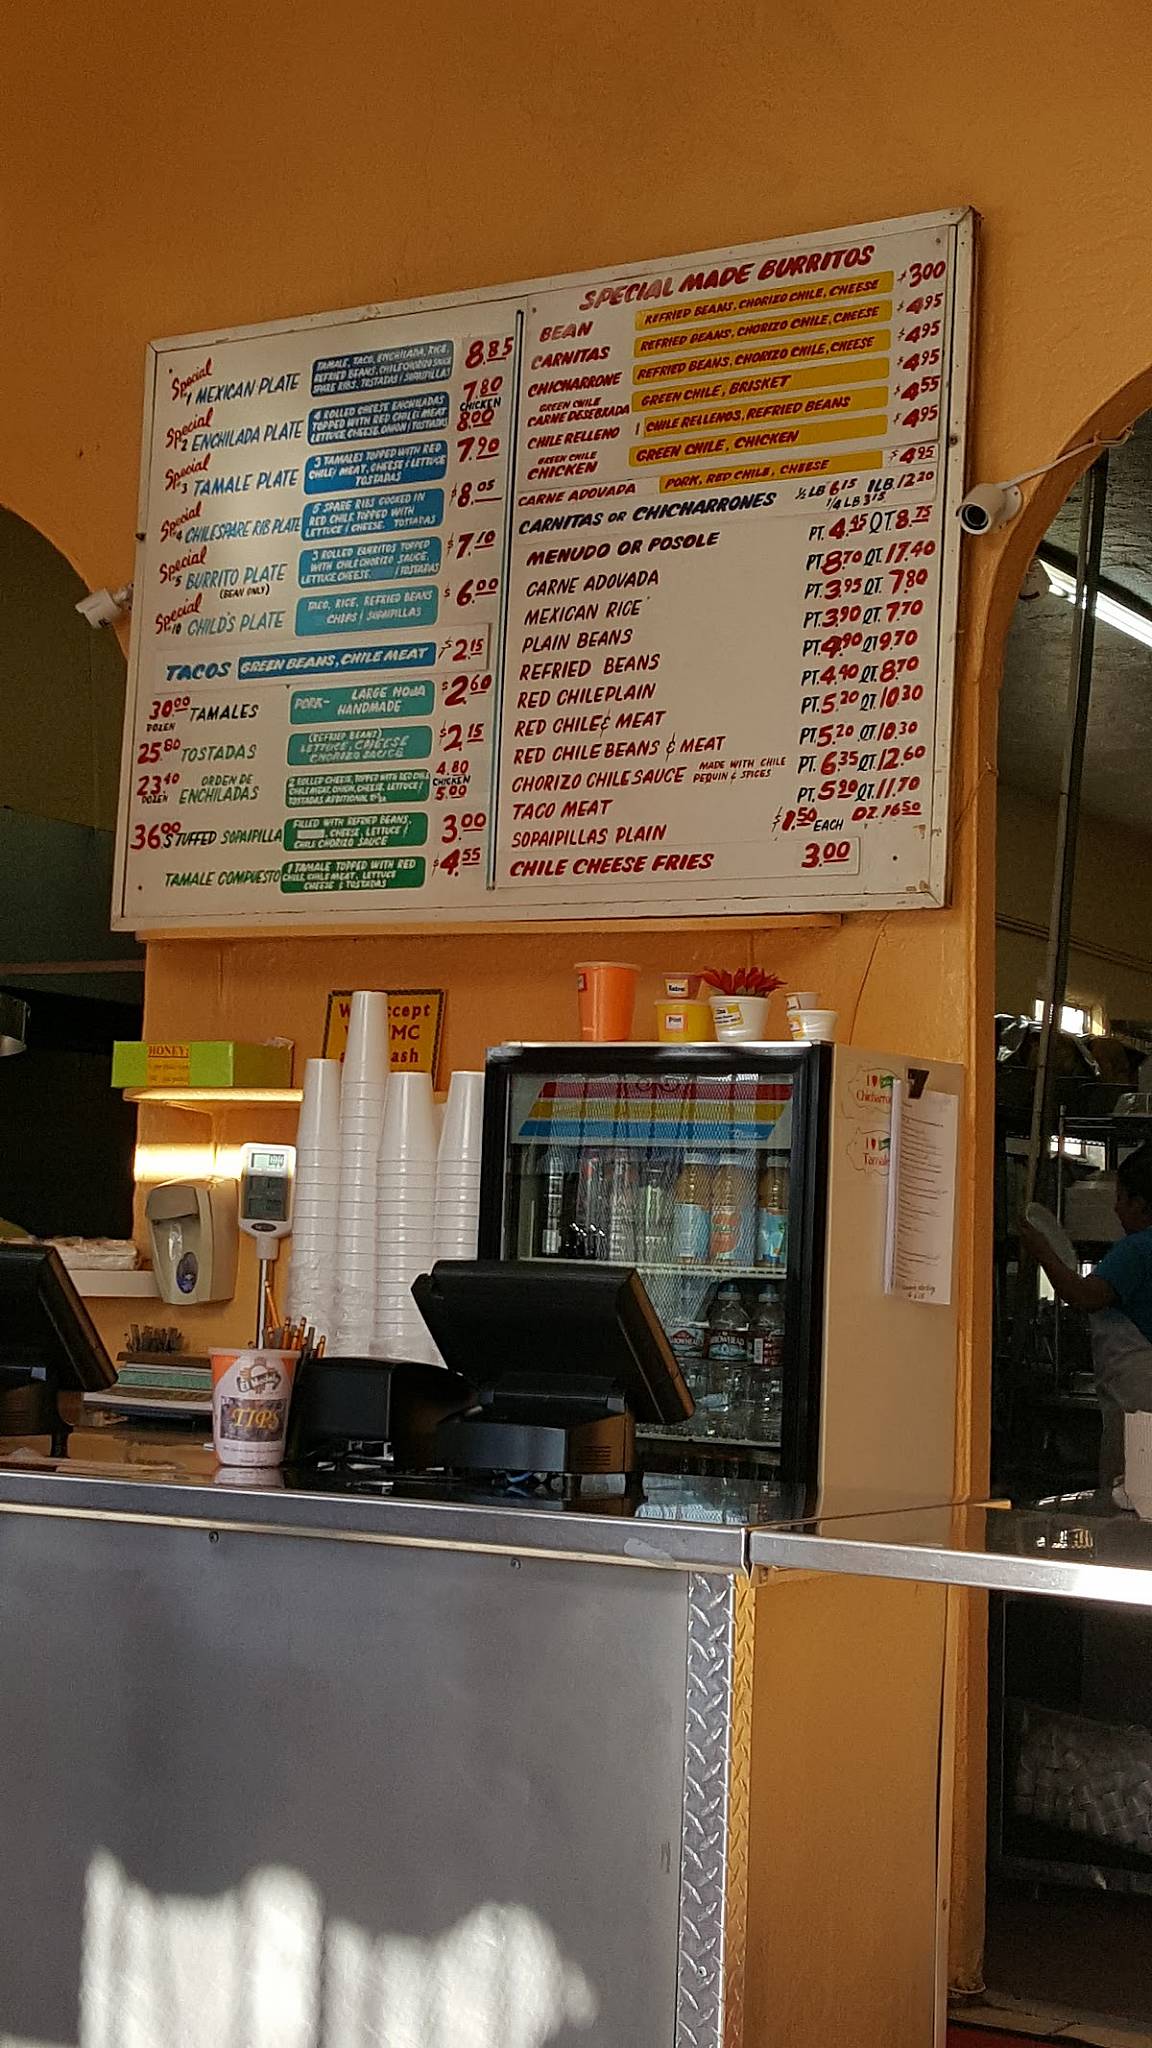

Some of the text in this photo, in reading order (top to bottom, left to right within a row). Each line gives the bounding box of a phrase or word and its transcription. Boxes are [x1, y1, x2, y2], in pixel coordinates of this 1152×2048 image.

[579, 245, 875, 311] SPECIAL MADE BURRITOS
[539, 321, 594, 343] BEAN
[640, 335, 687, 351] REFRIED
[737, 321, 788, 337] CHORIZO
[832, 306, 880, 324] CHEESE
[530, 346, 611, 371] CARNITAS
[637, 363, 685, 380] REFRIED
[734, 349, 788, 365] CHORIZO
[830, 336, 876, 352] CHEESE
[171, 357, 213, 401] Special
[527, 372, 622, 398] CHICHARRONE
[641, 391, 682, 407] GREEN
[728, 374, 792, 395] BRISKET
[459, 397, 501, 412] CHICKEN
[539, 397, 602, 412] GREEN CHILE
[645, 418, 680, 433] CHILE
[746, 402, 803, 420] REFRIED
[804, 396, 851, 412] BEANS
[165, 407, 214, 450] Special
[527, 411, 567, 427] CARNE
[527, 427, 620, 450] CHILE RELLENO
[636, 445, 681, 463] GREEN
[733, 430, 800, 449] CHICKEN
[324, 452, 364, 466] TAMALES
[366, 447, 397, 461] TOPPED
[397, 445, 421, 456] WITH
[422, 442, 441, 454] RED
[538, 451, 598, 465] GREEN CHILE
[165, 452, 211, 490] Special
[354, 472, 402, 488] TOSTADAS
[527, 461, 598, 480] CHICKEN
[518, 483, 635, 507] CARNE ADOVADA
[160, 500, 202, 543] Special
[308, 516, 327, 527] RED
[356, 509, 388, 522] TOPPED
[390, 506, 415, 518] WITH
[519, 512, 603, 535] CARNITAS
[632, 492, 777, 521] CHICHARRONES
[320, 547, 354, 560] ROLLED
[400, 539, 431, 551] TOPPED
[525, 531, 721, 566] MENUDO OR POSOLE
[159, 545, 207, 584] Special
[219, 588, 245, 600] (BEAN
[525, 569, 660, 598] CARNE ADOVADA
[155, 592, 203, 635] Special
[524, 599, 643, 626] MEXICAN RICE
[522, 628, 633, 653] PLAIN BEANS
[166, 661, 232, 681] TACOS
[240, 659, 285, 673] GREEN
[340, 649, 380, 665] CHILE
[383, 646, 430, 661] MEAT
[519, 653, 661, 681] REFRIED BEANS
[337, 700, 403, 716] HANDMADE
[517, 683, 657, 709] RED CHILE PLAIN
[189, 704, 259, 722] TAMALES
[514, 718, 547, 738] RED
[552, 714, 603, 734] CHILE
[615, 710, 667, 729] MEAT
[181, 744, 257, 762] TOSTADAS
[513, 747, 546, 765] RED
[552, 743, 601, 761] CHILE
[604, 740, 660, 759] BEANS
[679, 736, 726, 753] MEAT
[699, 756, 787, 770] MADE WITH CHILE
[201, 774, 253, 786] ORDEN DE
[432, 776, 471, 786] CHICKEN
[511, 766, 688, 793] CHORIZO CHILE SAUCE
[179, 785, 260, 805] ENCHILADAS
[512, 799, 613, 820] TACO MEAT
[317, 837, 355, 849] CHORIZO
[357, 836, 389, 847] SAUCE
[511, 824, 667, 848] SOPAIPILLAS PLAIN
[335, 859, 368, 871] TOPPED
[370, 859, 395, 869] WITH
[396, 858, 416, 869] RED
[509, 852, 715, 877] CHILE CHEESE FRIES
[165, 870, 281, 887] TAMALE COMPUESTO
[391, 1024, 420, 1040] MC
[390, 1048, 419, 1063] ash
[232, 1408, 280, 1431] TIPS
